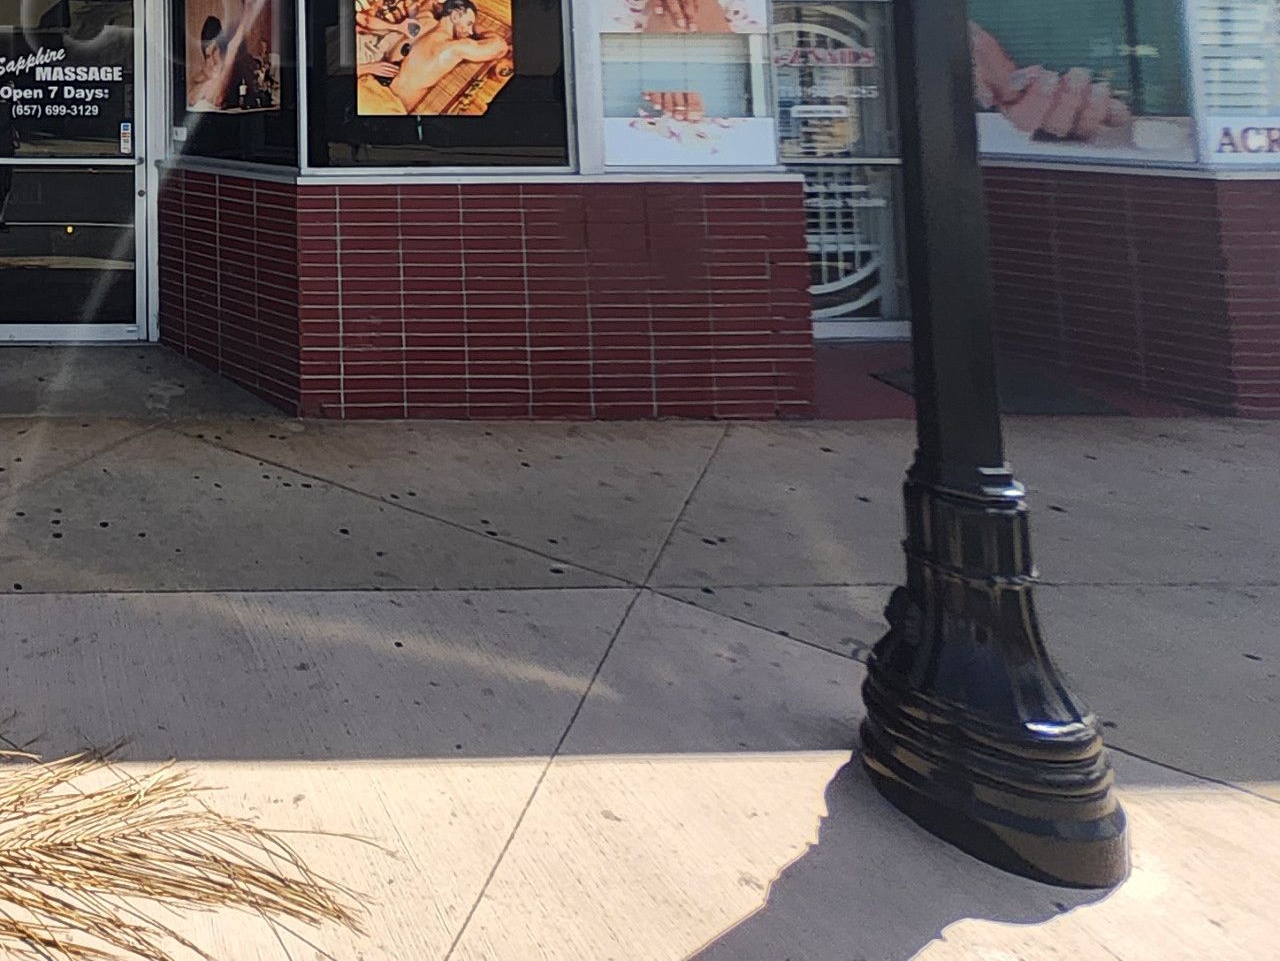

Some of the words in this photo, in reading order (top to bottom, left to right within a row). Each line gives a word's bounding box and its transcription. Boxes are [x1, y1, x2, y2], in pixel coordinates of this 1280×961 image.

[35, 66, 123, 81] MASSAGE
[0, 86, 43, 101] Open
[48, 86, 59, 99] 7
[64, 86, 110, 101] Days:
[11, 104, 42, 118] (657)
[45, 104, 99, 116] 699-3129
